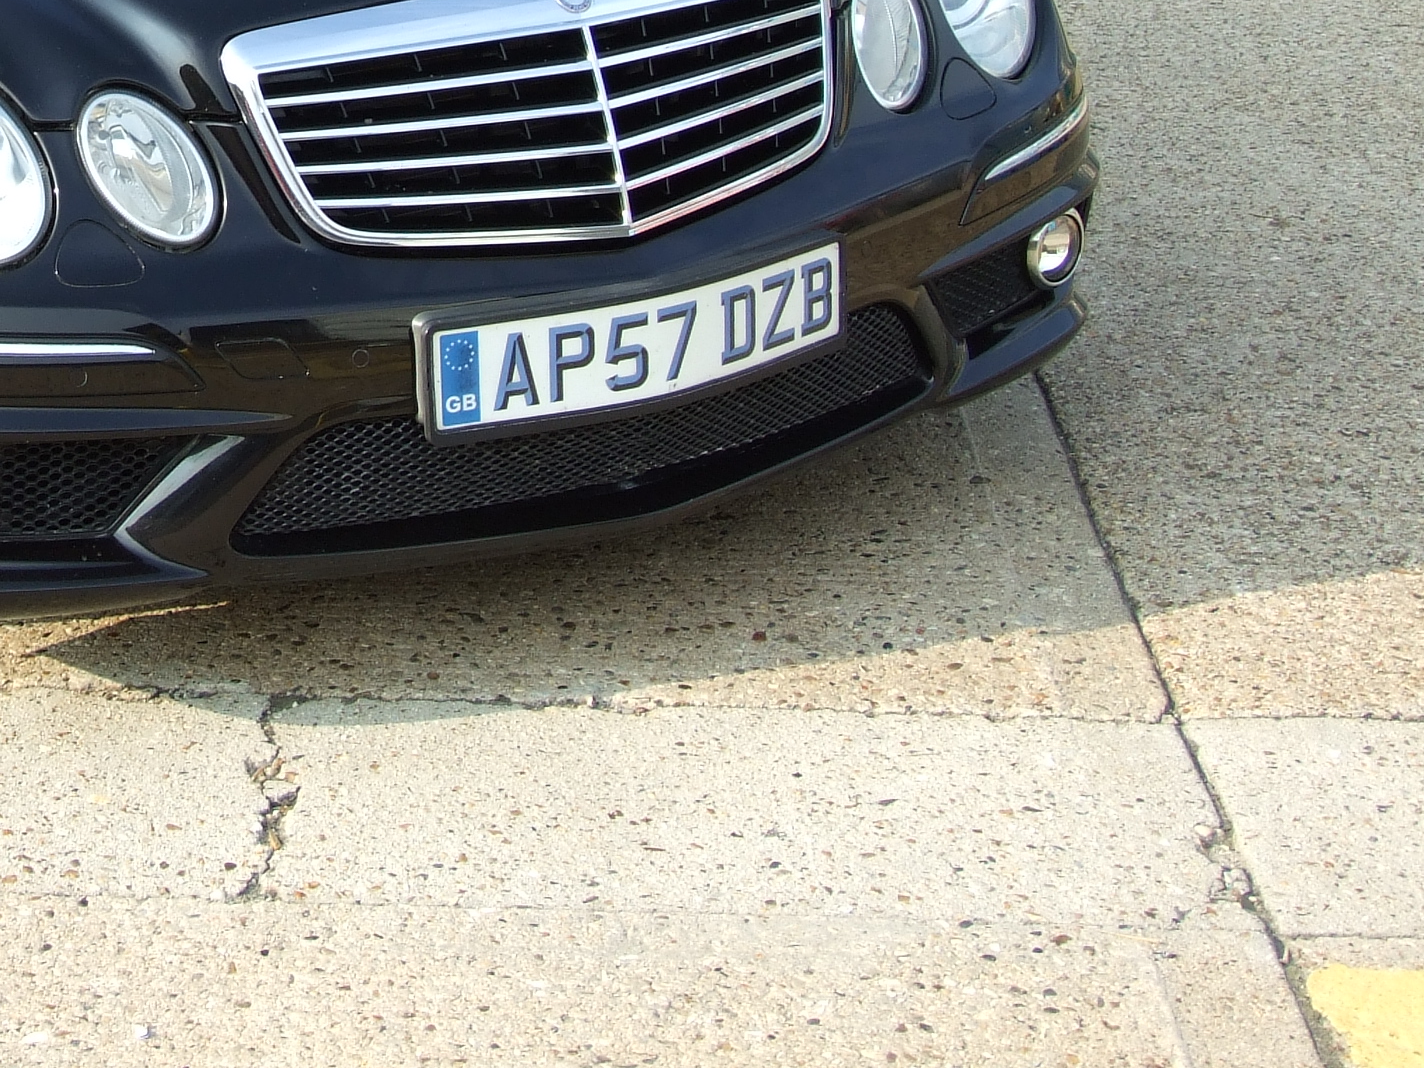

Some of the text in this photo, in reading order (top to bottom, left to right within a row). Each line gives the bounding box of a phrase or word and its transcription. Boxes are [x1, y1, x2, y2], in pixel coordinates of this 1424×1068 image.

[493, 257, 832, 411] AP57 DZB
[445, 393, 477, 413] GB
